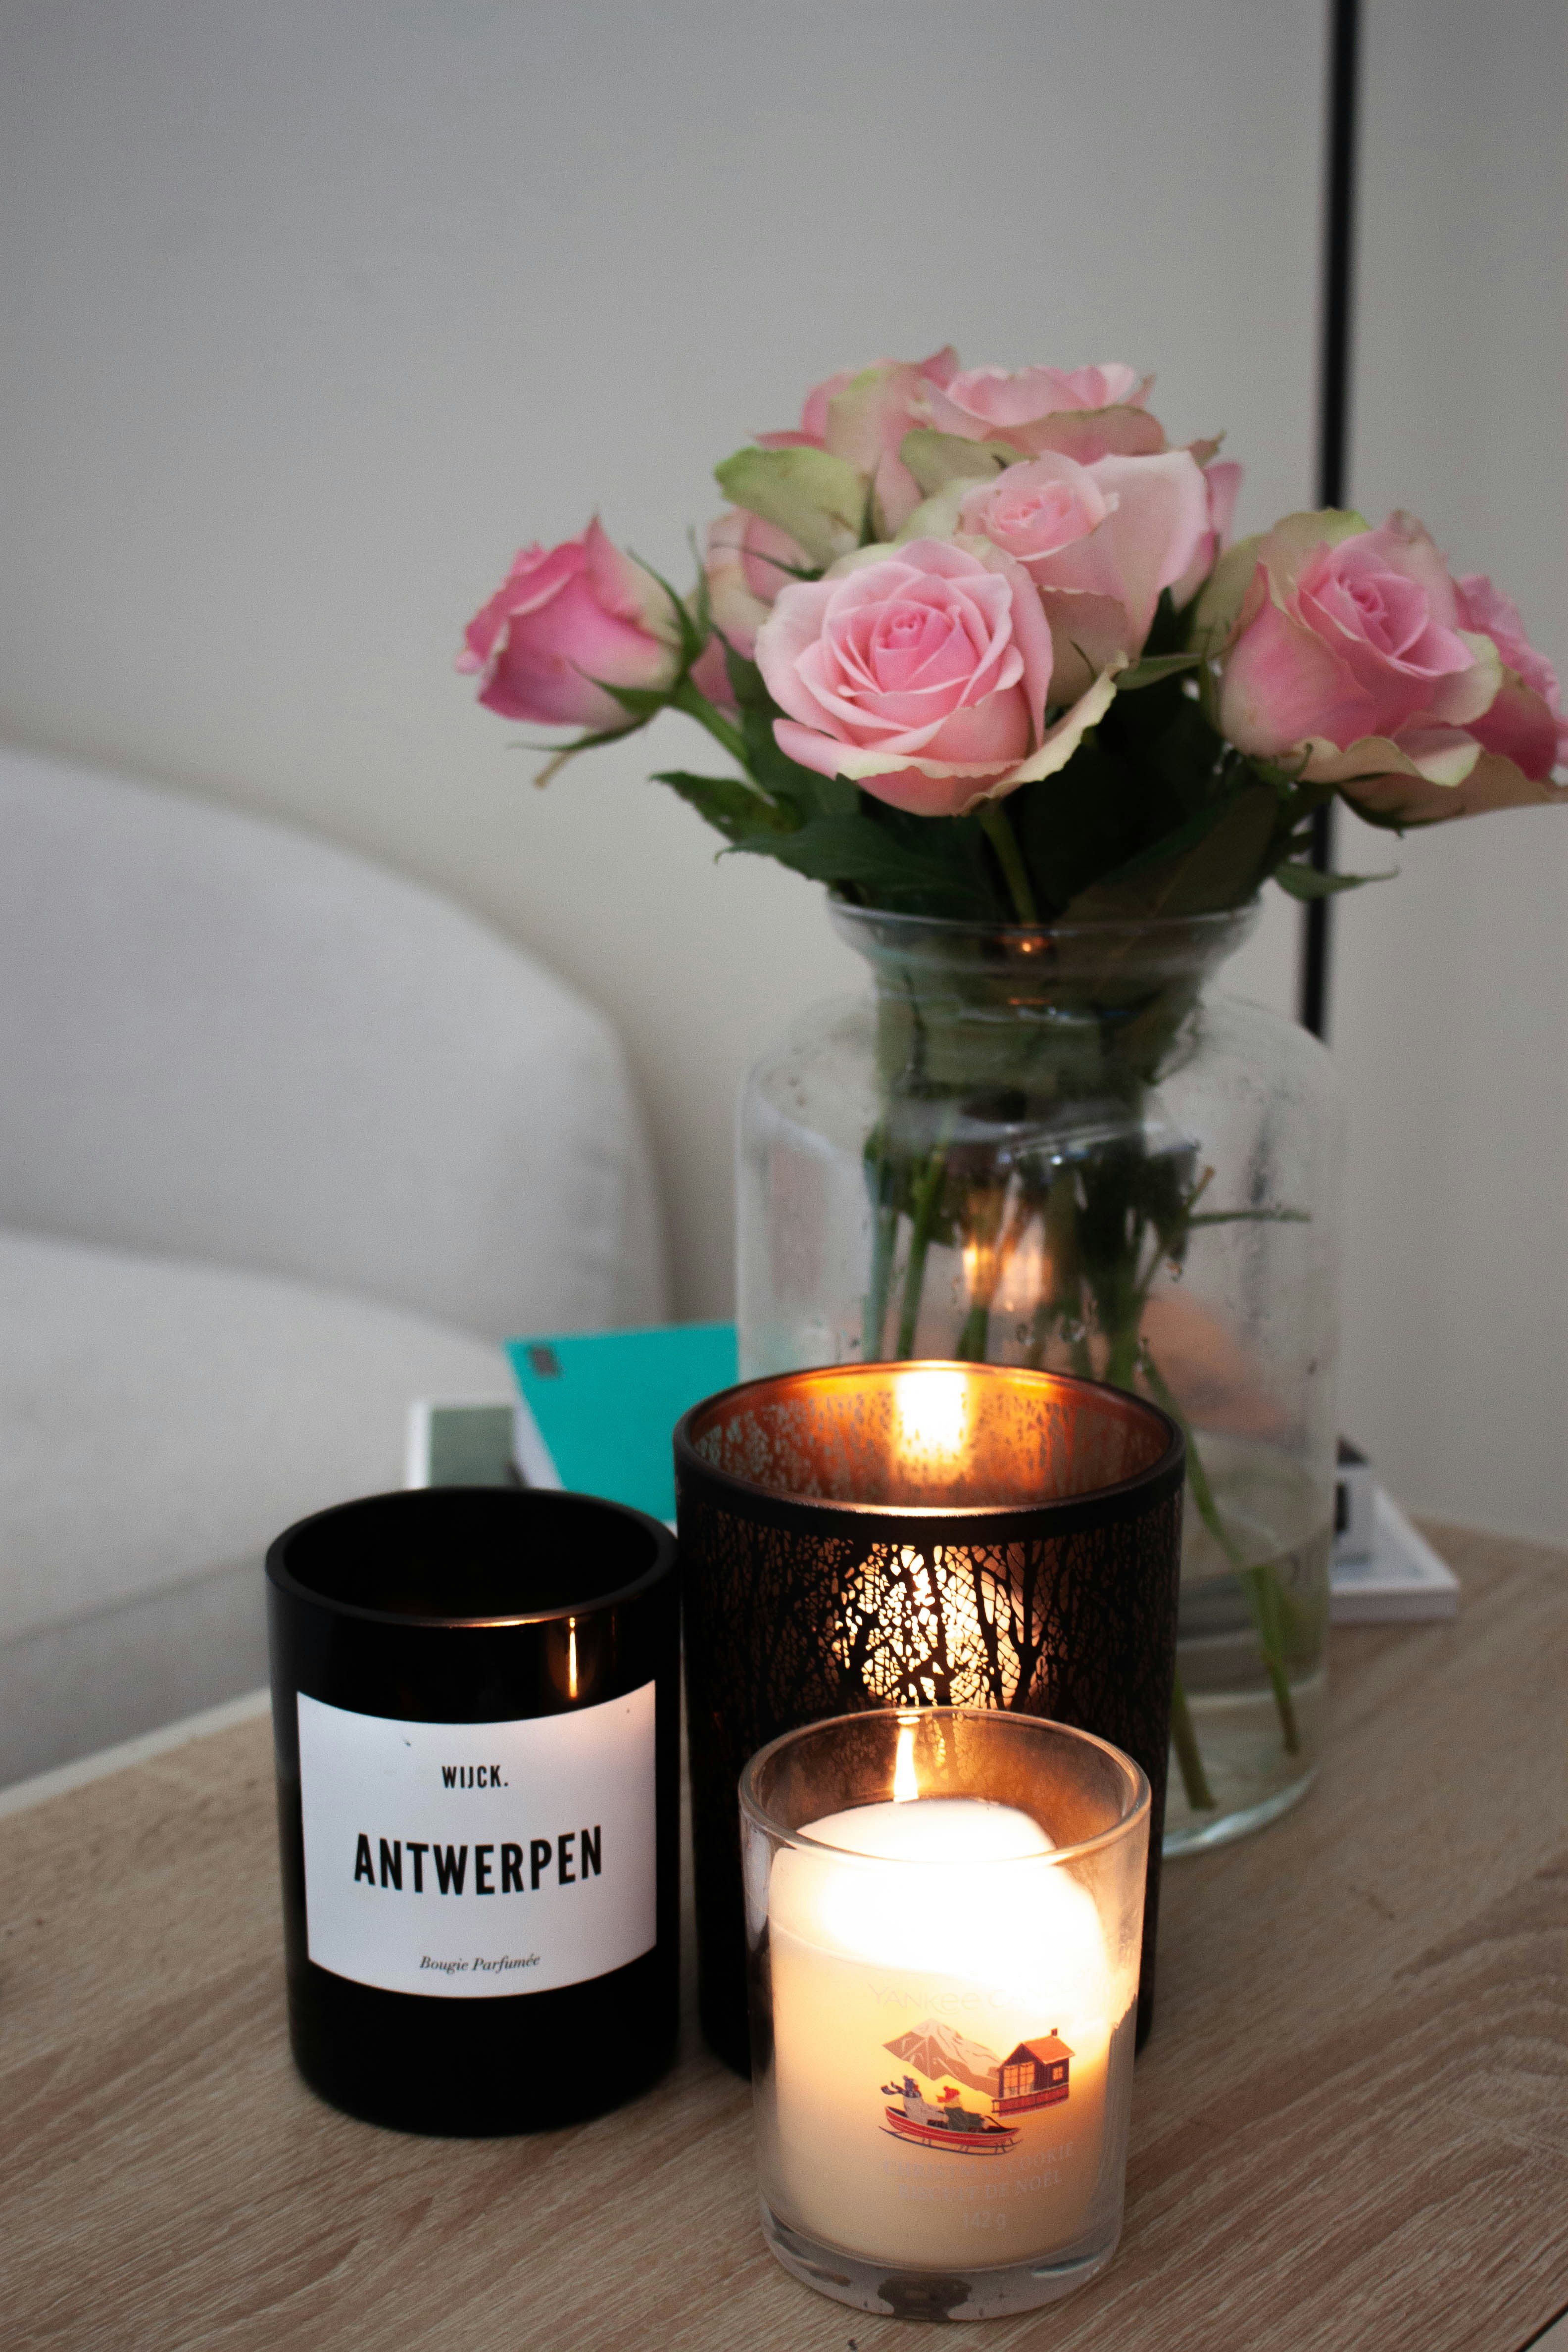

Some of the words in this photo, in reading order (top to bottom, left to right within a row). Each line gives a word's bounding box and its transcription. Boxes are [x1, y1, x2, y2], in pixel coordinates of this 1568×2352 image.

[442, 1765, 509, 1788] WIJCK.
[354, 1825, 602, 1895] ANTWERPEN
[420, 1956, 468, 1974] Bougie
[472, 1954, 540, 1974] Parfumée
[883, 2159, 1002, 2179] CHRISTMAS
[1007, 2141, 1075, 2173] COOKIE
[898, 2182, 979, 2202] BISCUIT
[985, 2182, 1009, 2200] DE
[963, 2211, 992, 2229] 142
[996, 2212, 1006, 2231] g
